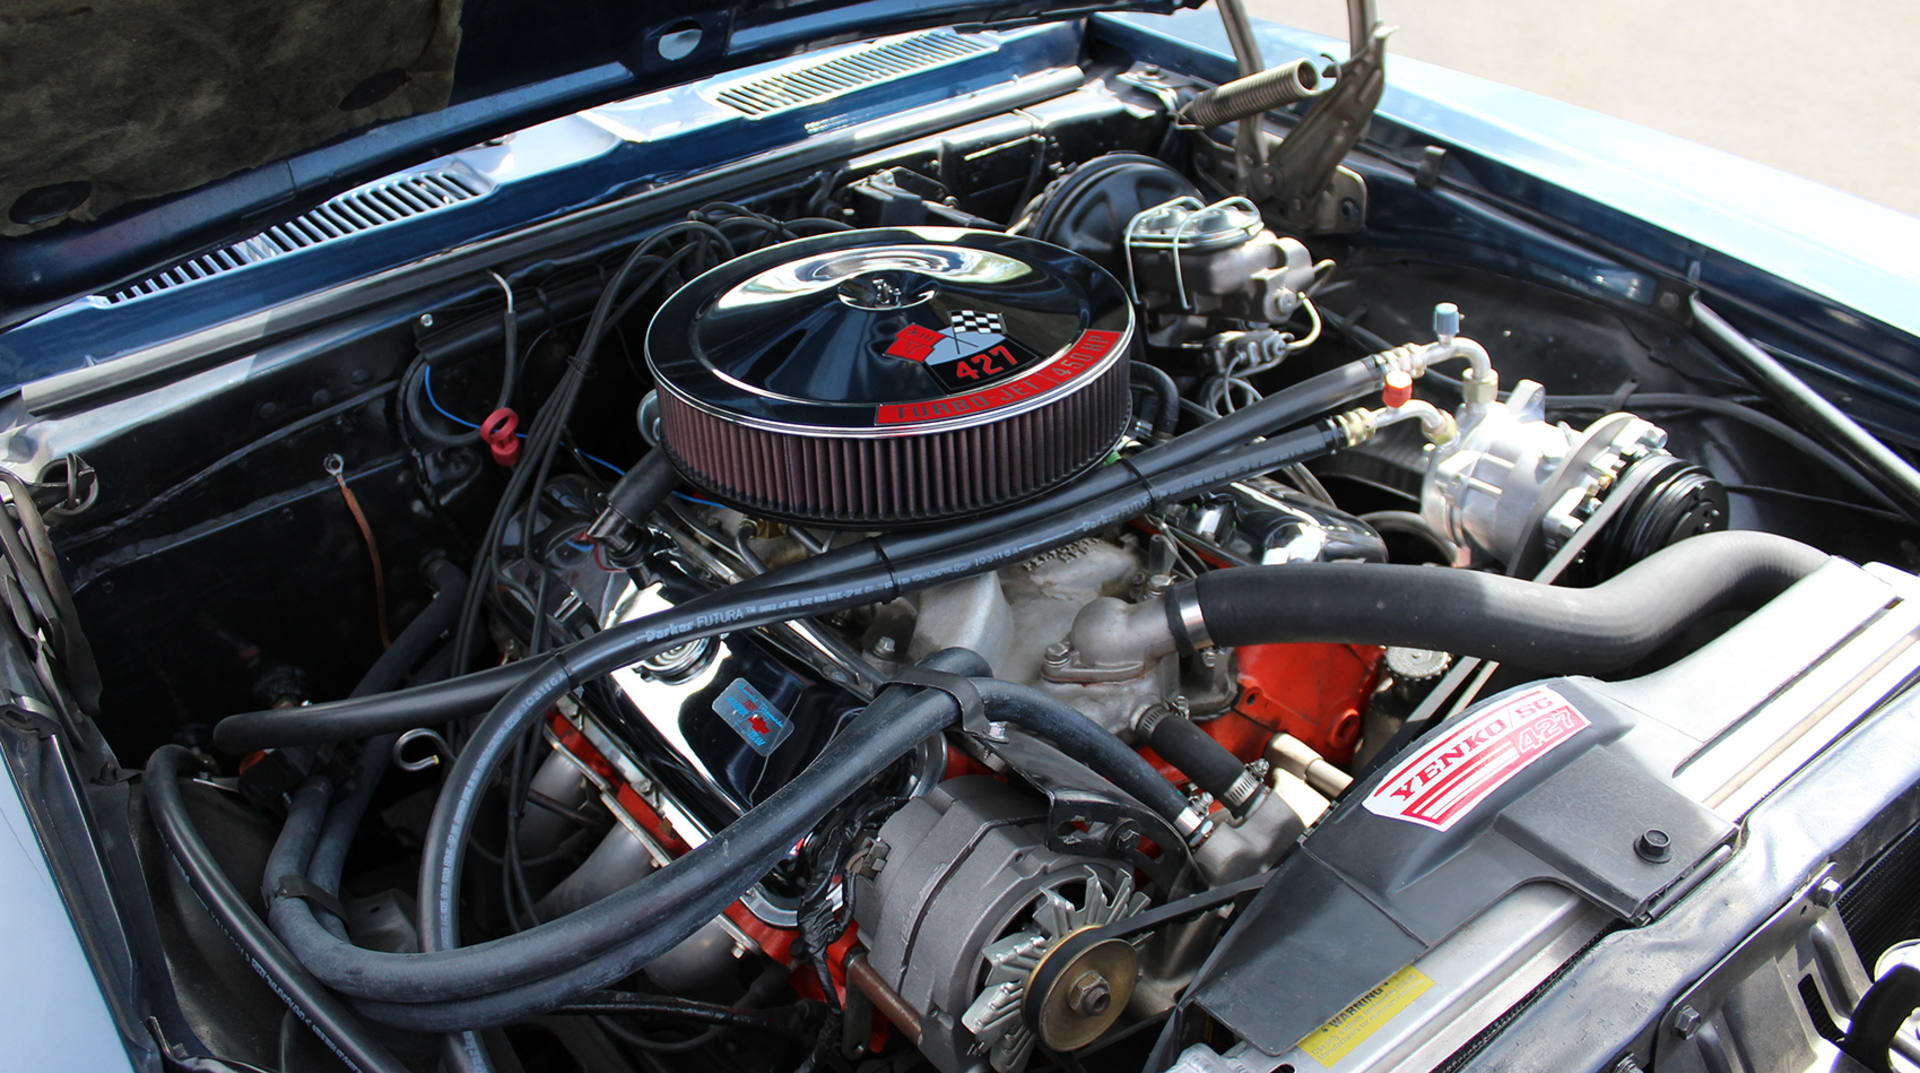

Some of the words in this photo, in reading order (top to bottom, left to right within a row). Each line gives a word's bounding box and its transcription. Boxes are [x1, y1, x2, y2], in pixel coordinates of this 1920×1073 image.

[897, 380, 1039, 420] TURBO-JET
[1053, 347, 1093, 377] 450
[1087, 334, 1109, 352] HP
[957, 346, 1017, 379] 427
[646, 621, 694, 642] Parker
[696, 609, 744, 628] FUTURA
[1390, 696, 1553, 802] YENKO/SC
[1518, 709, 1574, 754] 427
[1328, 987, 1384, 1028] WARNING
